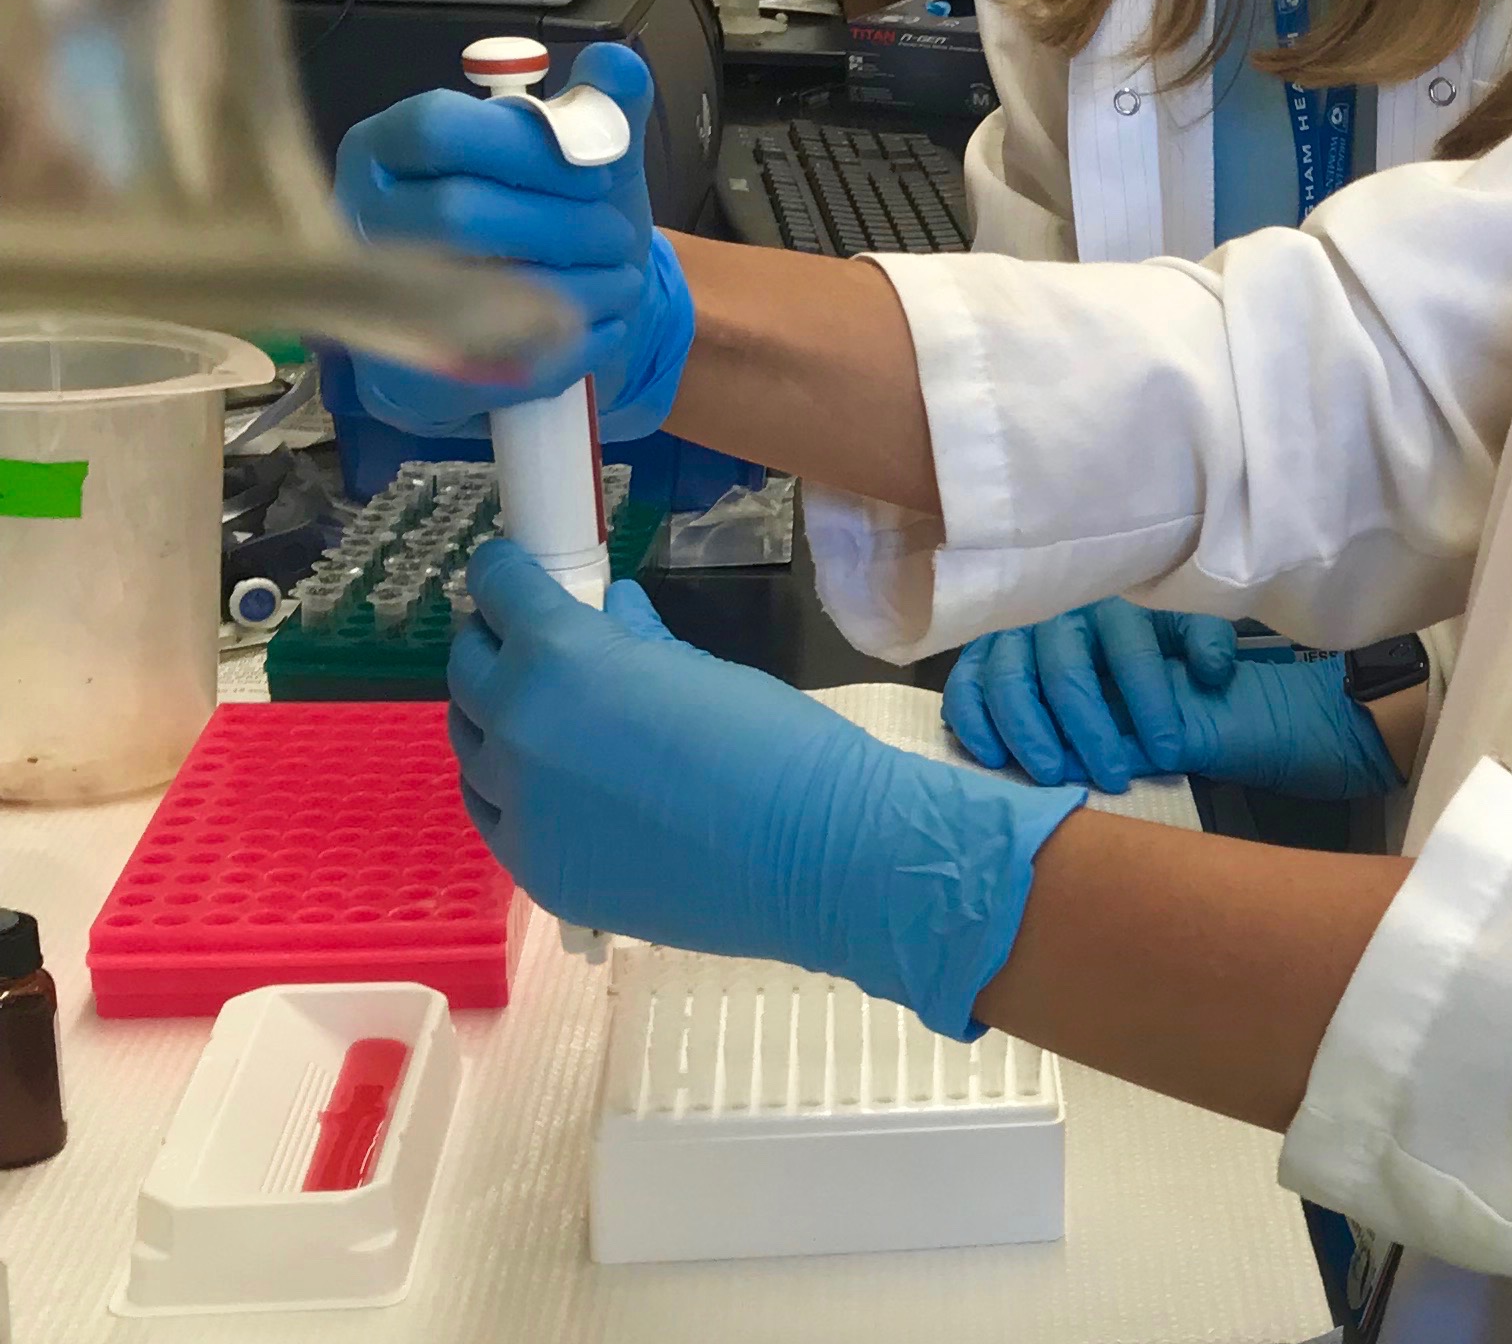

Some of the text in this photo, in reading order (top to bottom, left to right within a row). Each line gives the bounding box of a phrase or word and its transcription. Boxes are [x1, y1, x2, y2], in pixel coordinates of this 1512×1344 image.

[851, 28, 896, 45] TITAN
[1286, 32, 1315, 215] GHAM HEAH
